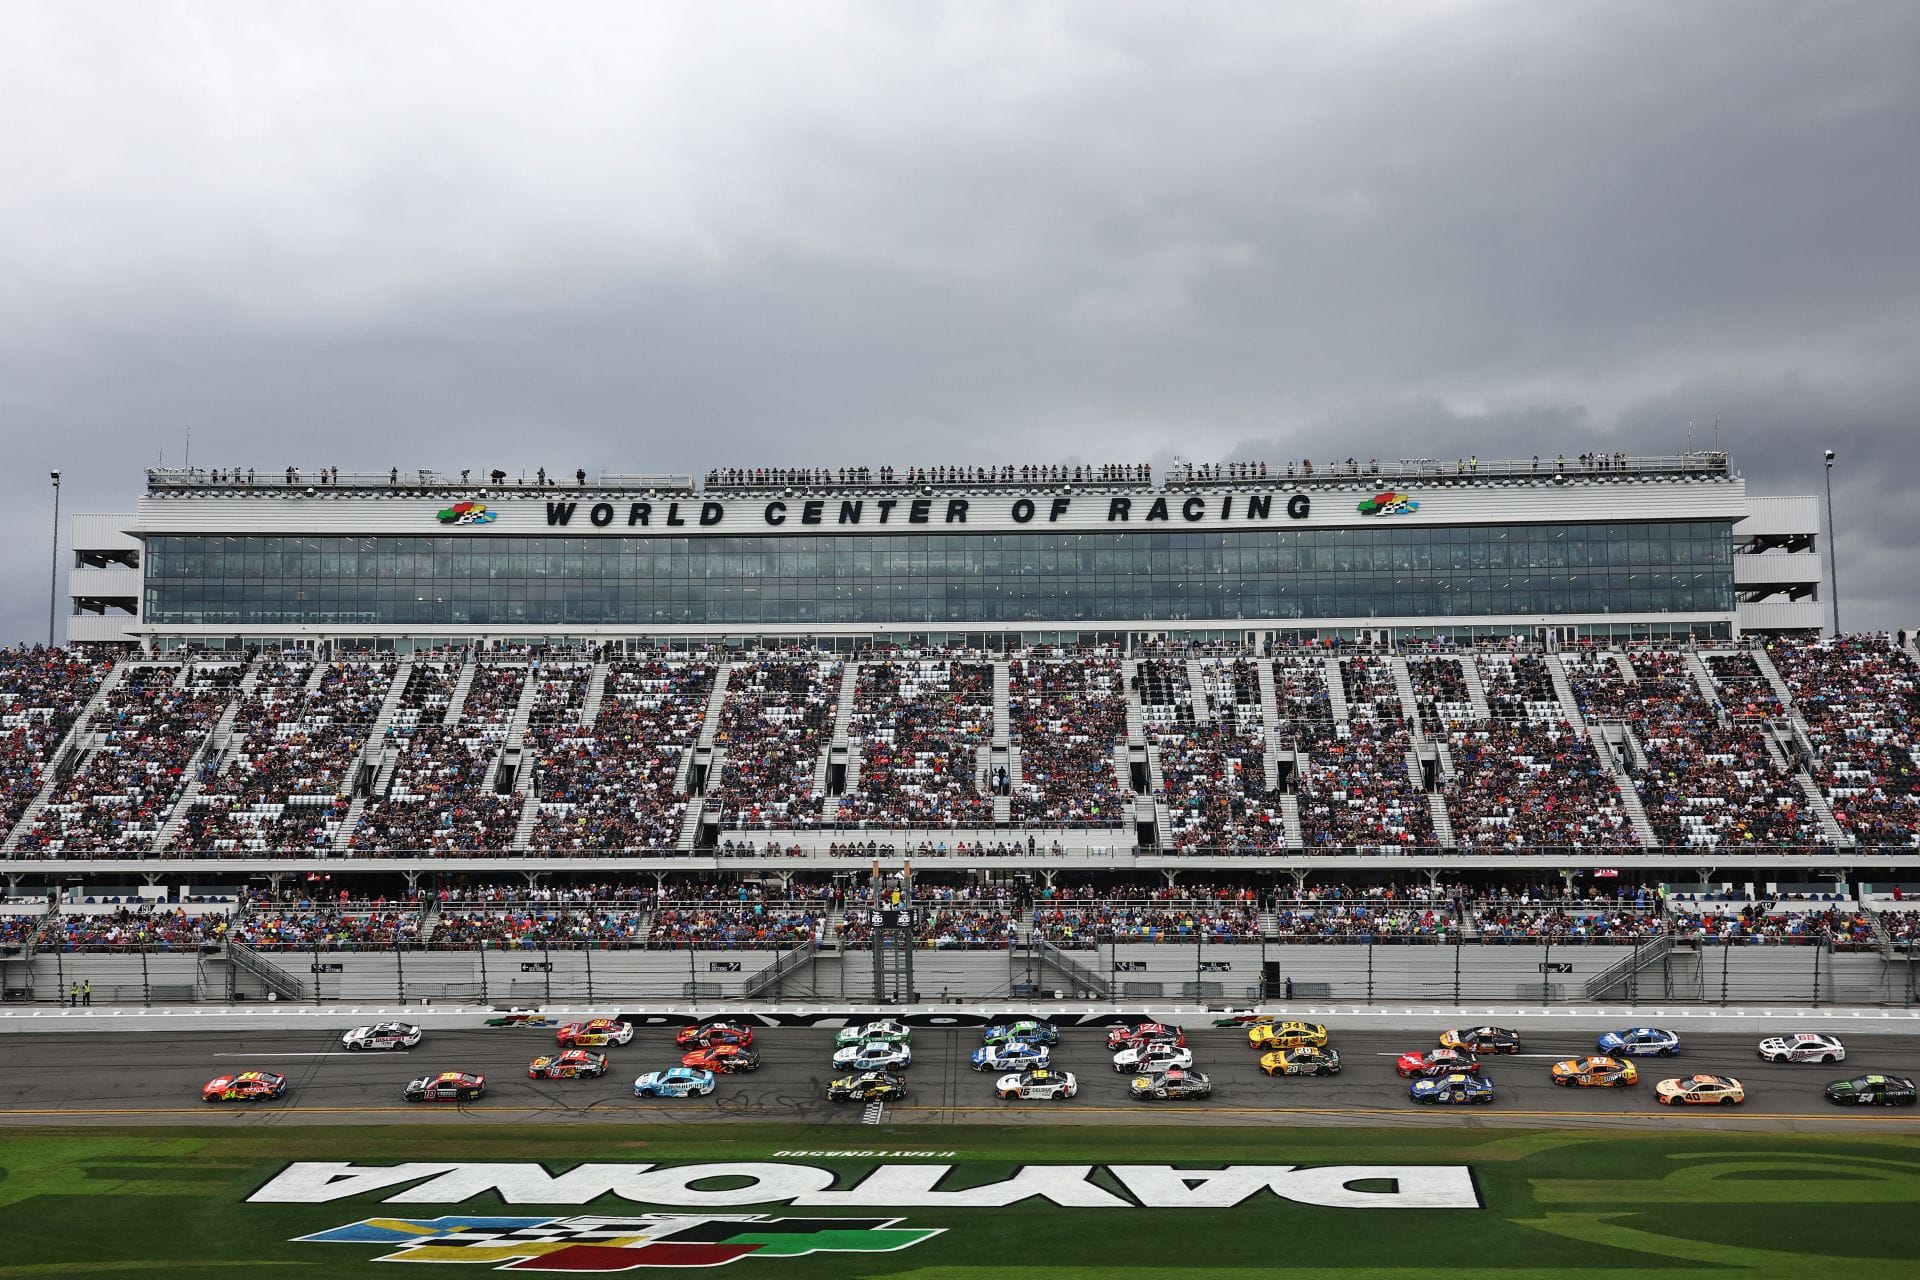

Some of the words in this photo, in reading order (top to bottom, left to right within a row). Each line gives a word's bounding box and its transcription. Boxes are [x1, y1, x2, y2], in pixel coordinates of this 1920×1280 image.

[546, 502, 724, 527] WORLD
[764, 499, 970, 525] CENTER
[1011, 498, 1071, 523] OF
[1107, 494, 1312, 521] RACING
[363, 1039, 374, 1048] 2
[579, 1036, 592, 1044] 22
[700, 1039, 711, 1047] 01
[1274, 1038, 1289, 1047] 34
[565, 1050, 582, 1058] 19
[1591, 1056, 1607, 1064] 47
[1137, 1062, 1149, 1071] 11
[1286, 1065, 1299, 1073] 20
[1425, 1066, 1439, 1075] 41
[549, 1068, 561, 1077] 19
[860, 1072, 878, 1080] 45
[1032, 1070, 1049, 1078] 16
[1580, 1075, 1592, 1084] 47
[224, 1090, 236, 1099] 24
[849, 1090, 864, 1099] 45
[1019, 1088, 1031, 1096] 16
[1153, 1087, 1168, 1097] 3
[1685, 1093, 1701, 1101] 40
[245, 1161, 1483, 1208] DAYTONA
